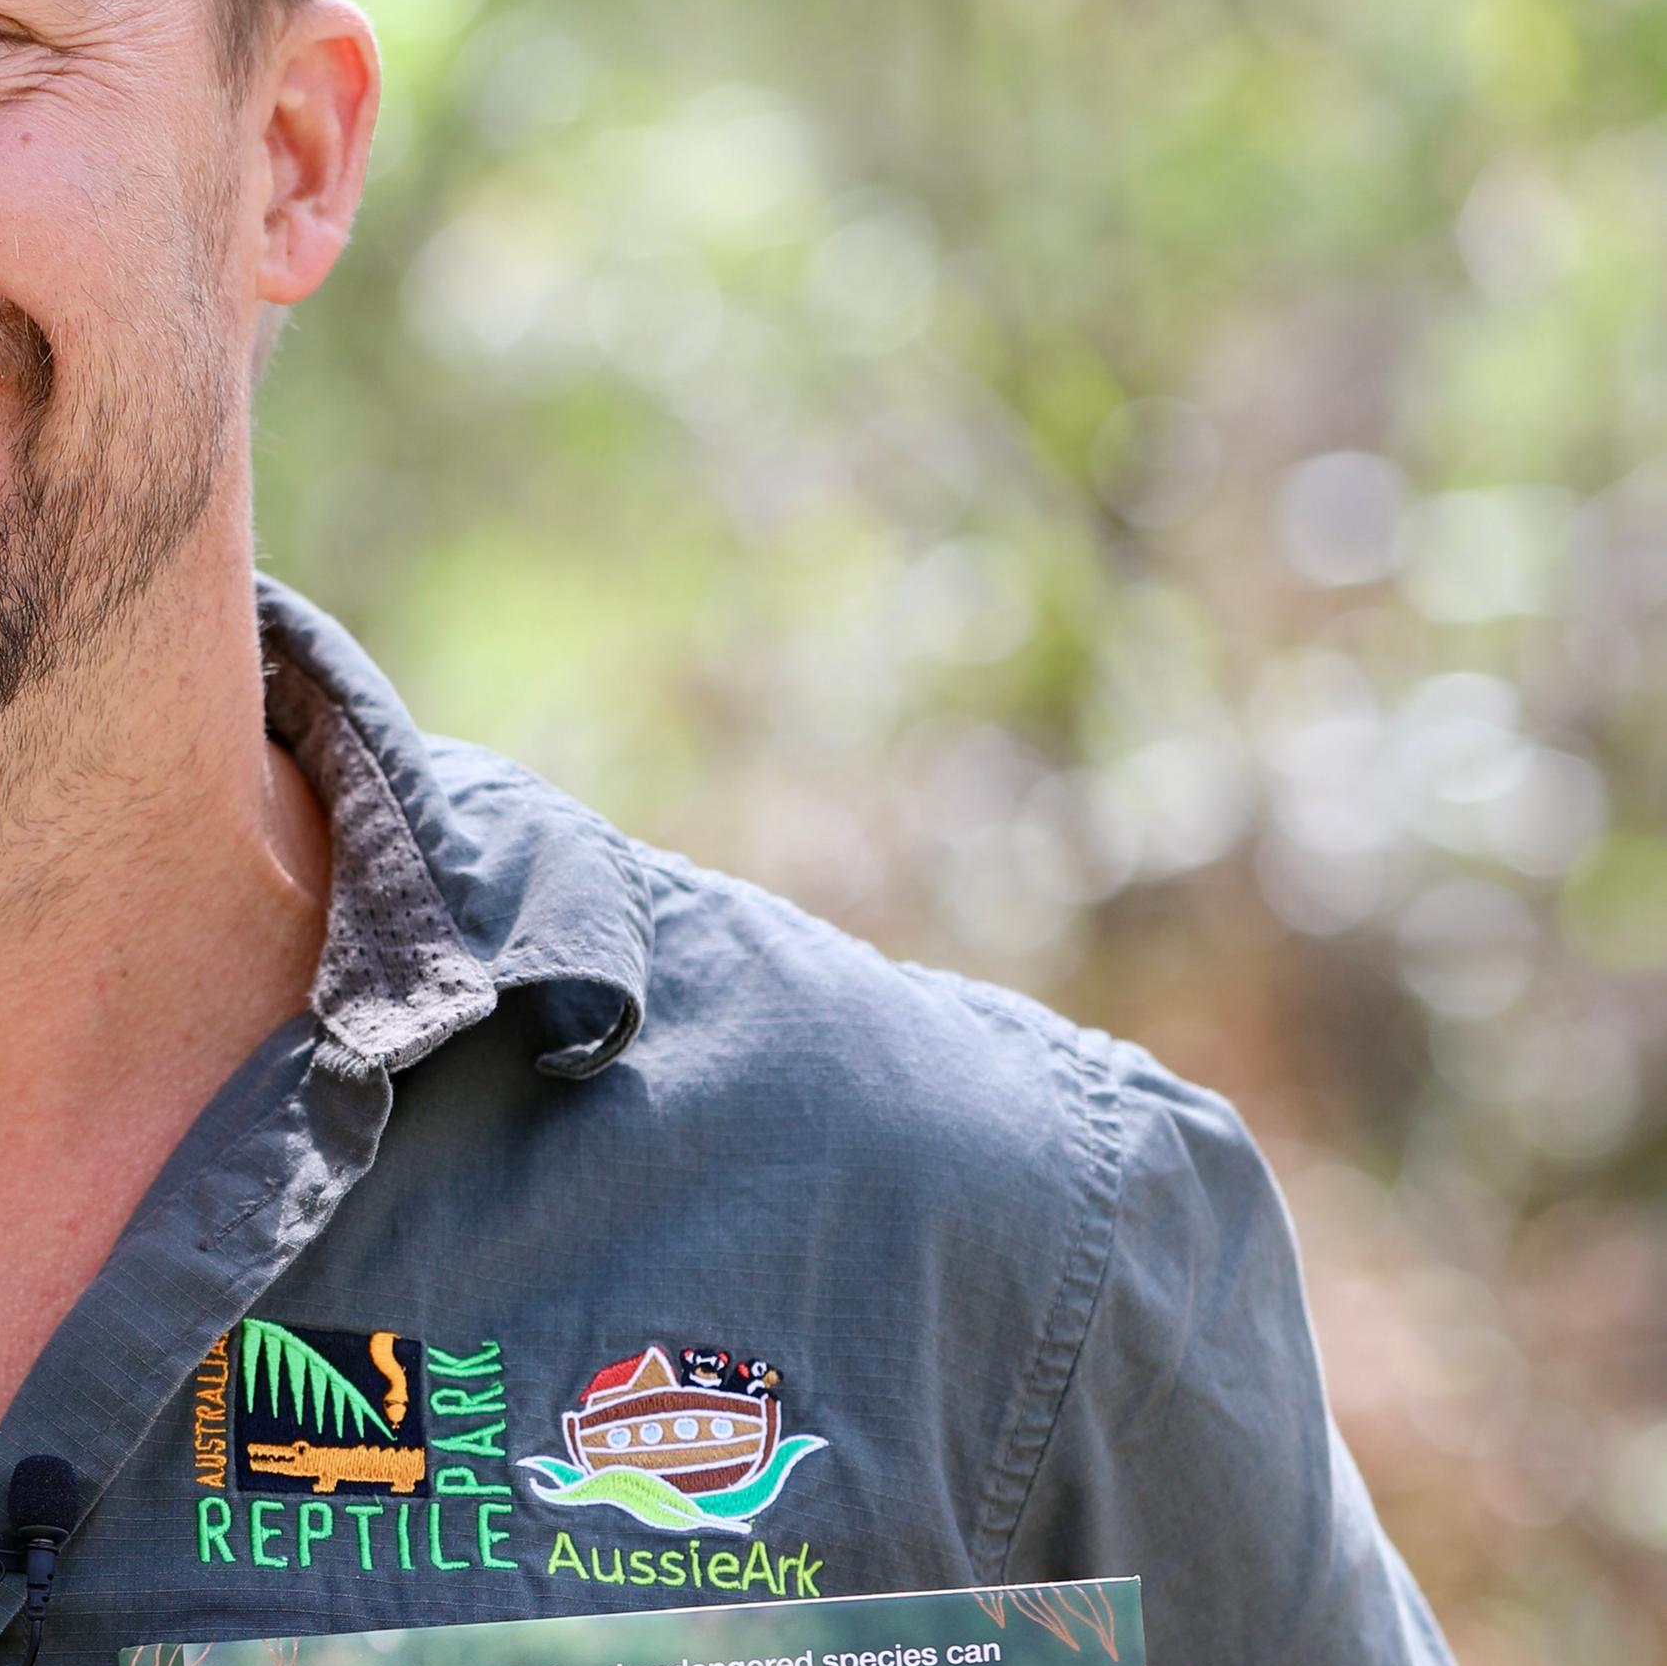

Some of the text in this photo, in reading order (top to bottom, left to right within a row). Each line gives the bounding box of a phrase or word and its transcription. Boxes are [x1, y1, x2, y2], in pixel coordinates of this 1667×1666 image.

[427, 1340, 512, 1497] PARK
[198, 1495, 517, 1571] REPTILE
[548, 1532, 824, 1597] AussieArk
[946, 1642, 1001, 1665] can
